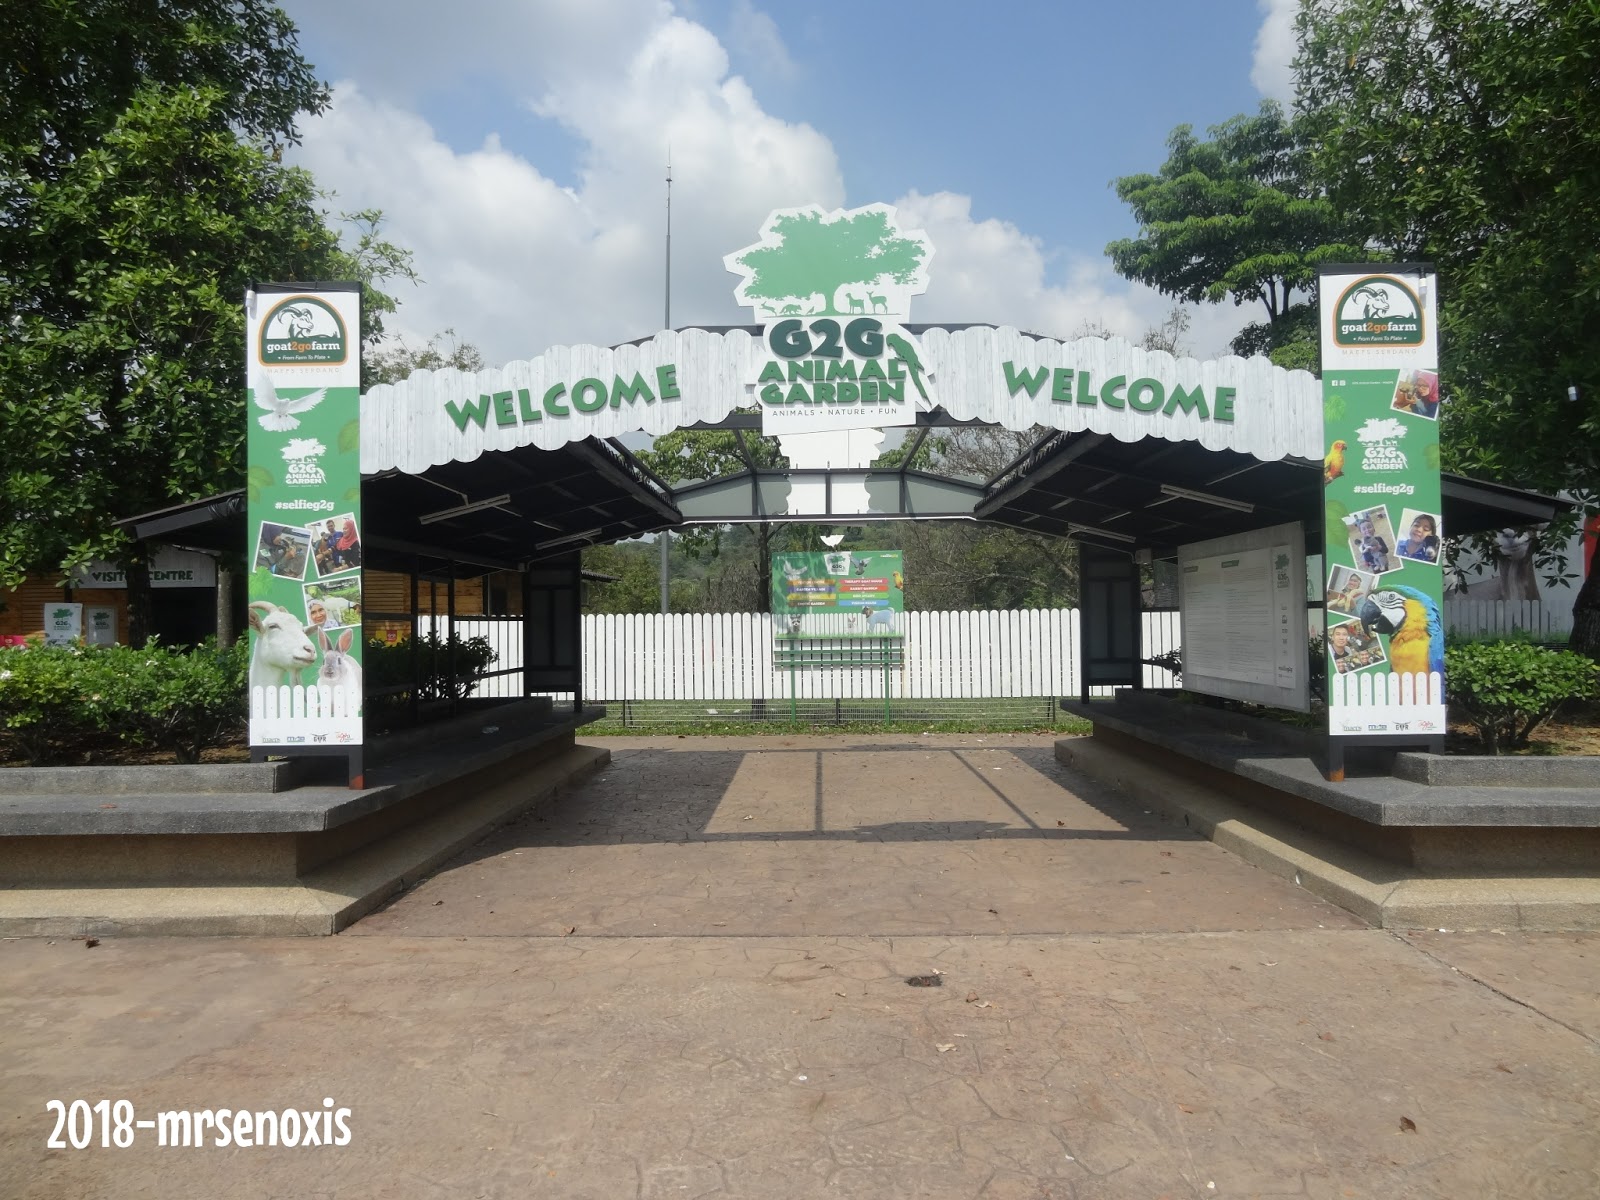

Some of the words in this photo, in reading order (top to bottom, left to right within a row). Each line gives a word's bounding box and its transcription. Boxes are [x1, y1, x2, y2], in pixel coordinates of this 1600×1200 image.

[1341, 321, 1418, 334] goat2gofarm
[769, 317, 885, 358] G2G
[266, 341, 341, 353] goat2gofarm
[758, 359, 907, 382] ANIMAL
[760, 381, 905, 404] GARDEN
[1002, 360, 1237, 421] WELCOME
[444, 364, 681, 432] WELCOME
[772, 409, 815, 417] ANIMALS
[828, 408, 866, 416] NATURE
[1364, 447, 1397, 458] G2G
[288, 463, 316, 474] G2G
[1353, 483, 1415, 495] #selfieg2g
[275, 499, 335, 511] #selfieg2g
[92, 570, 128, 582] VISIT
